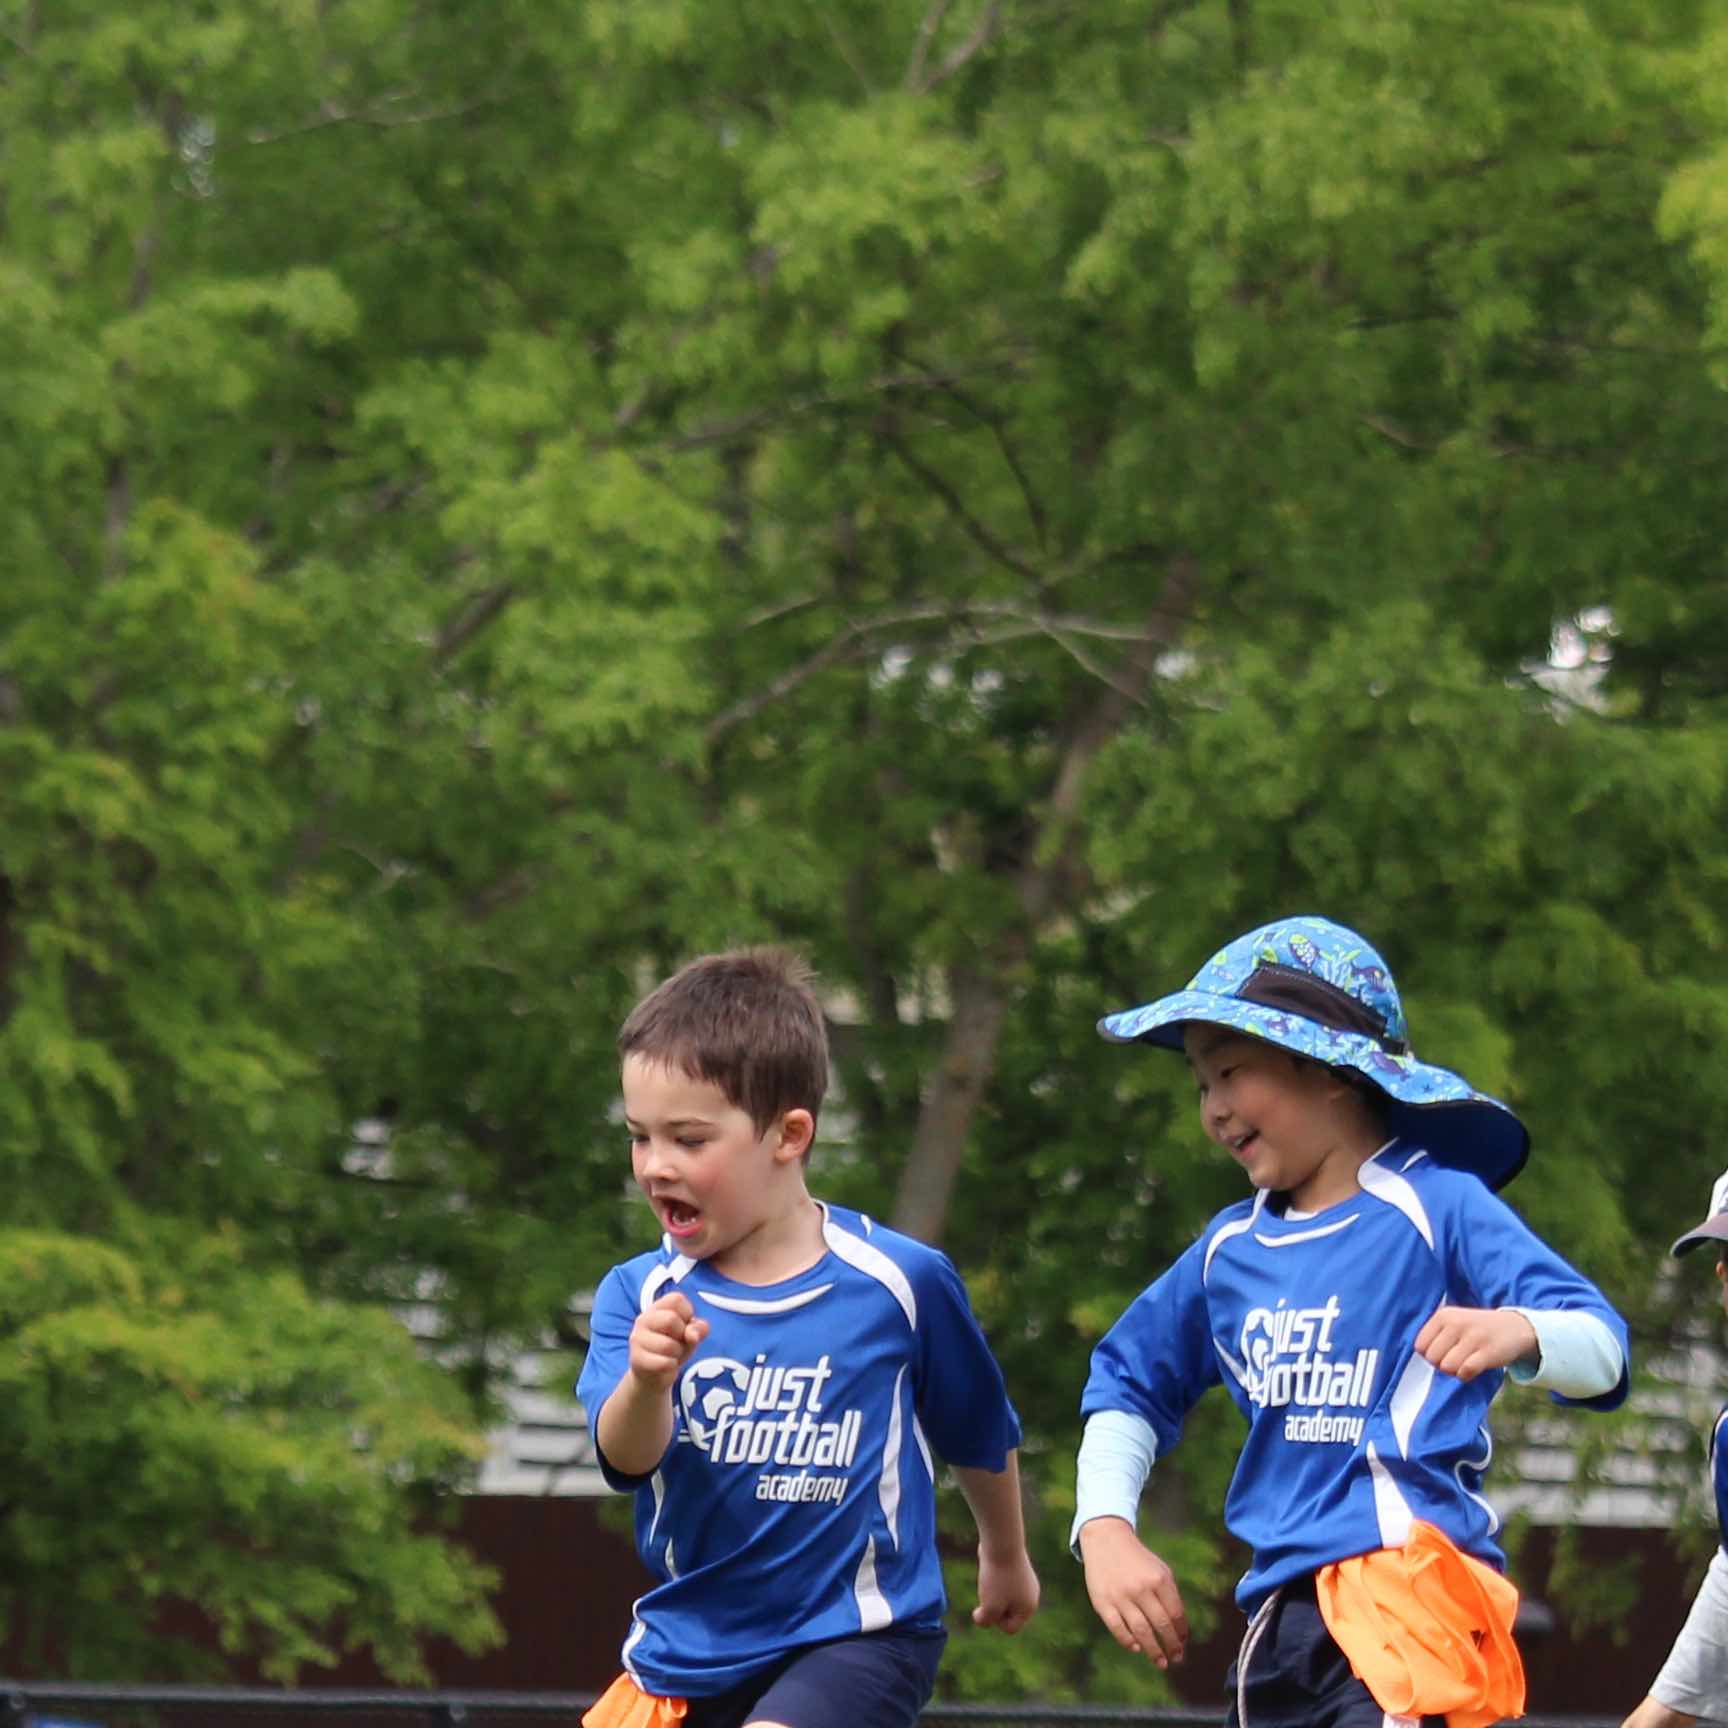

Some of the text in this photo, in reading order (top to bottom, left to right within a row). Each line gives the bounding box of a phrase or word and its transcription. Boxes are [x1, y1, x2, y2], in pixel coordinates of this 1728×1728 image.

[1271, 1295, 1340, 1363] just
[736, 1354, 832, 1416] just
[710, 1405, 863, 1468] football
[1284, 1409, 1365, 1447] academy
[755, 1469, 849, 1506] academy
